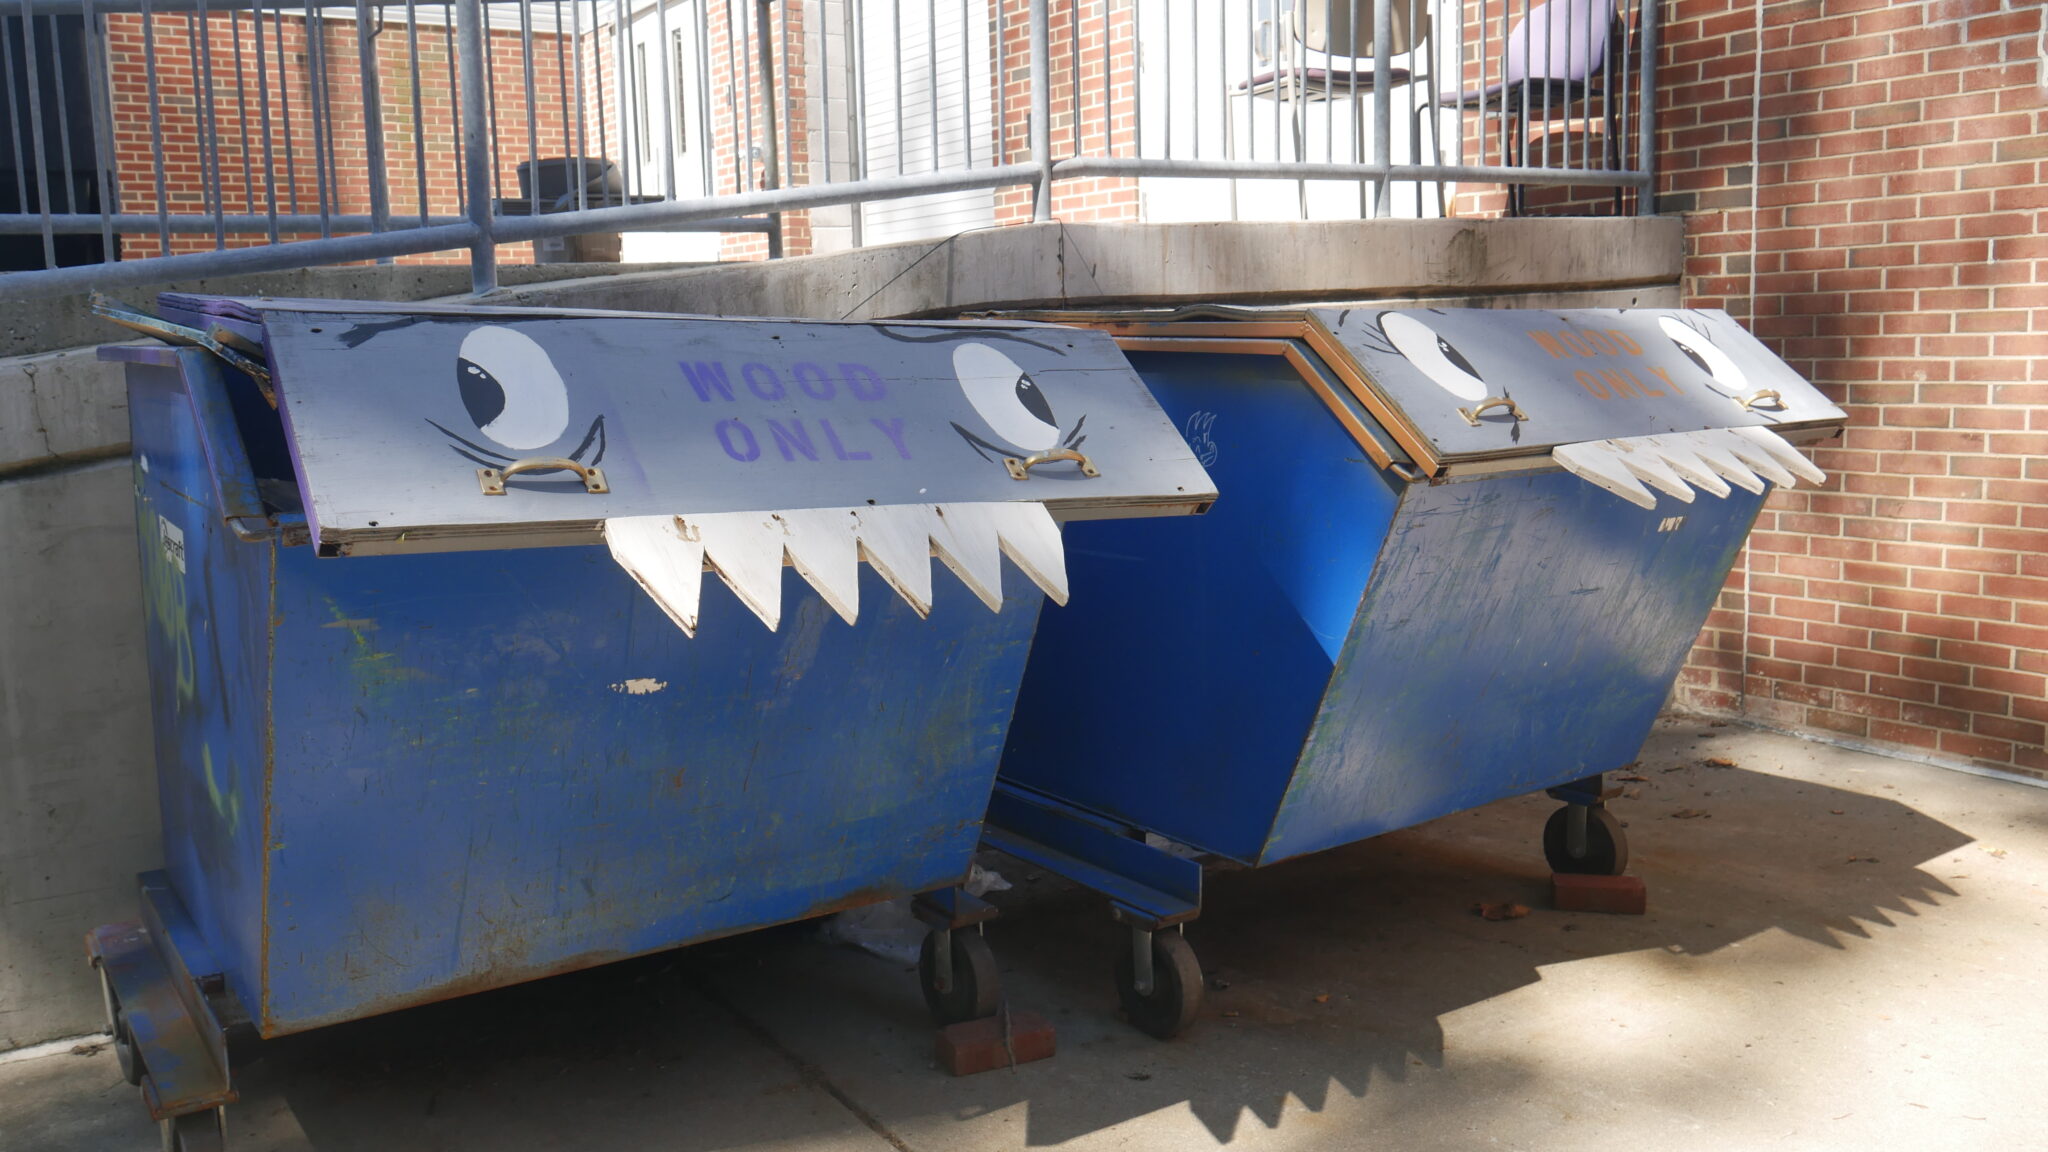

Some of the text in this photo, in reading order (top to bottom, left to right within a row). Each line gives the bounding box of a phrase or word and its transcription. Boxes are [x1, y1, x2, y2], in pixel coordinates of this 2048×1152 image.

[1526, 329, 1643, 358] WOOD
[678, 361, 888, 402] WOOD
[1573, 367, 1685, 400] ONLY
[714, 418, 912, 462] ONLY
